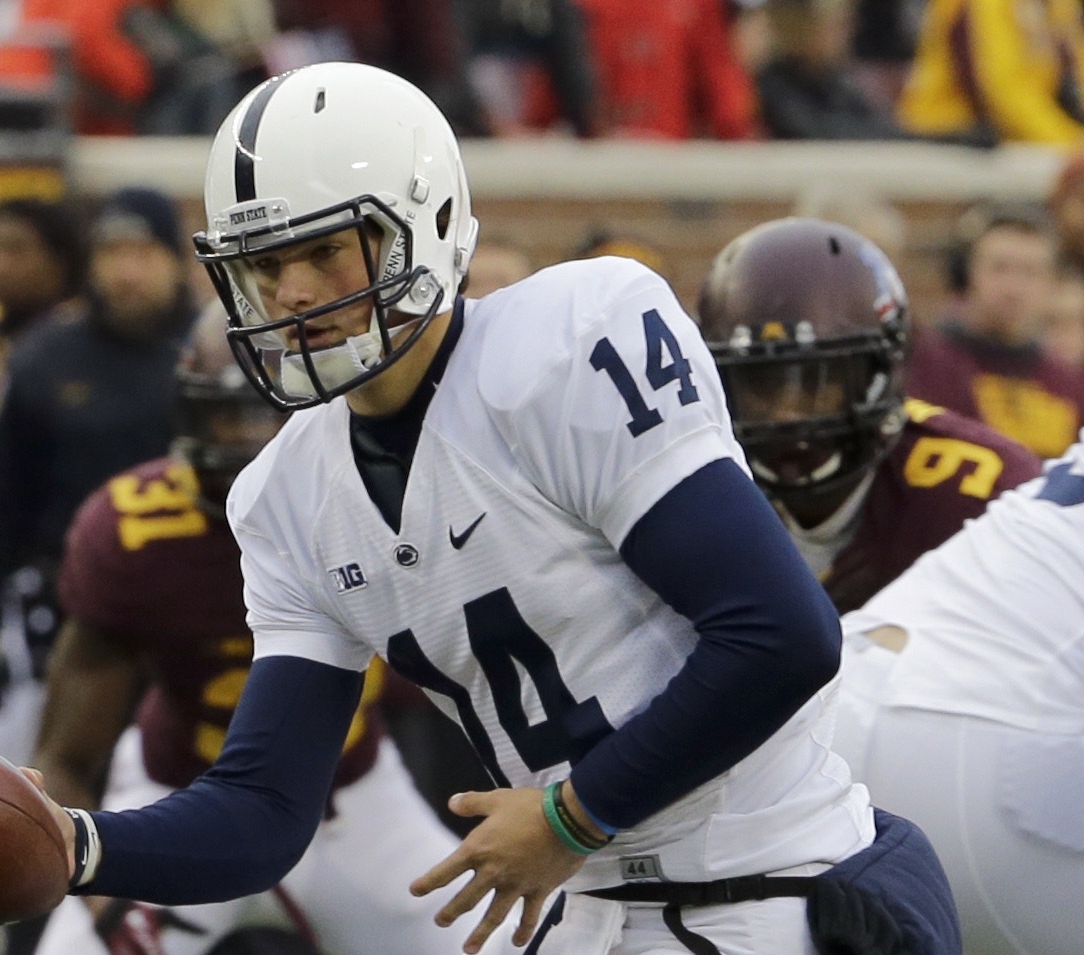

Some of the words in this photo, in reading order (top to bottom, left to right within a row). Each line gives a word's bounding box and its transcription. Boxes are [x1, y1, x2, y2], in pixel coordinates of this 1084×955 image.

[382, 251, 404, 281] PENN
[396, 210, 417, 250] STTE
[589, 308, 700, 438] 14
[111, 463, 207, 551] 31
[387, 586, 618, 790] 14
[627, 861, 646, 875] 44
